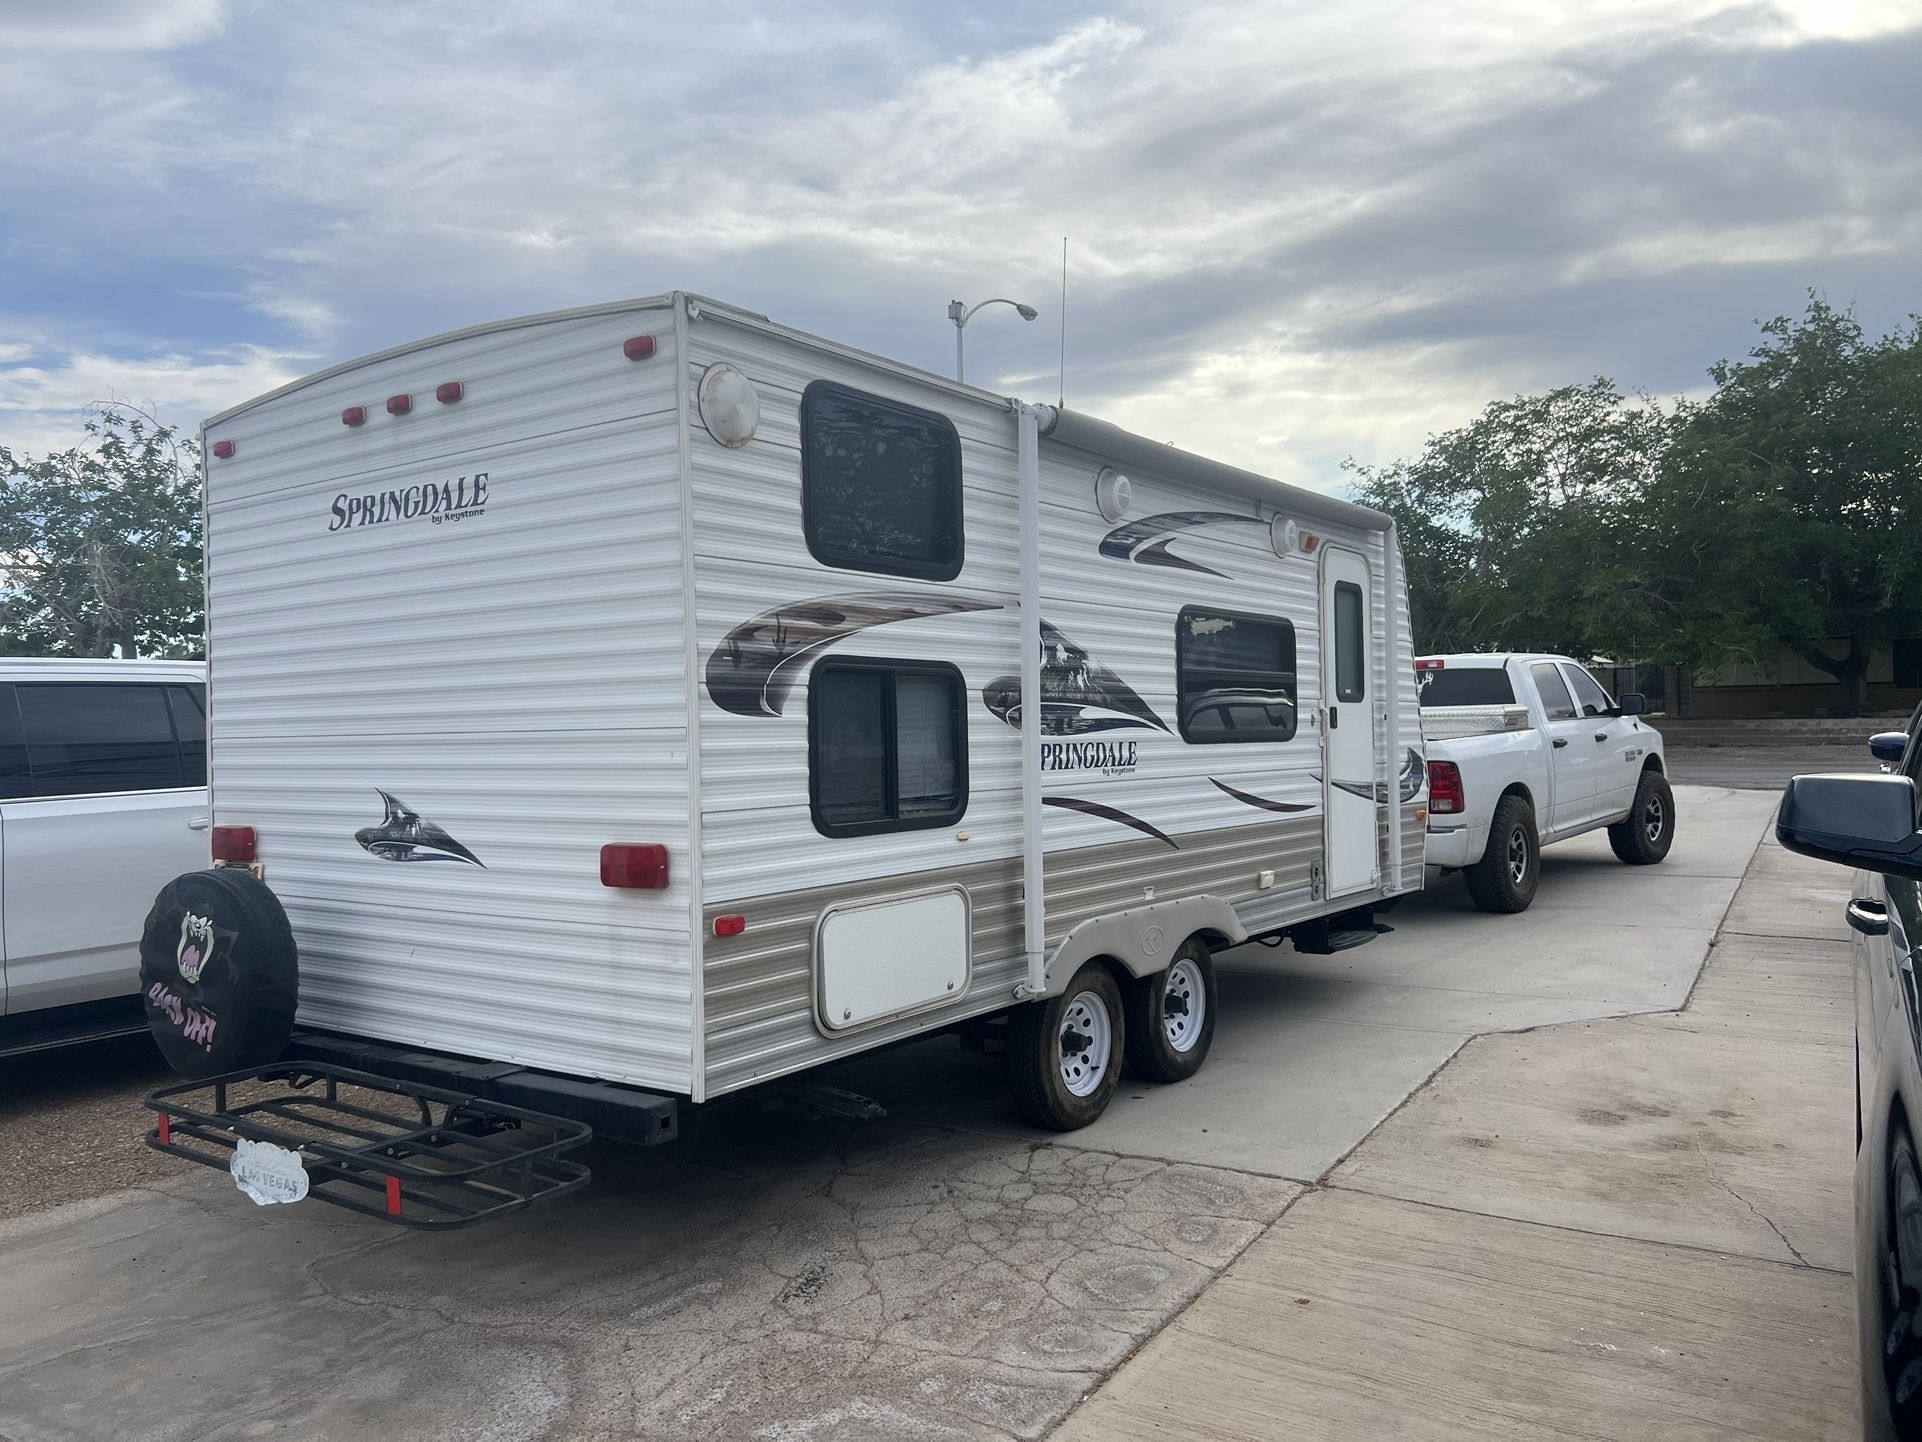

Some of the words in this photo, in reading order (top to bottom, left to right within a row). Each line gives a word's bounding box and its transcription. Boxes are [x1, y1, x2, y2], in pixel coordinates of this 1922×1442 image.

[328, 473, 489, 531] SPRINGDALE
[431, 513, 442, 525] by
[444, 508, 485, 522] Keystone
[1041, 741, 1138, 770] PRINGDALE
[1102, 768, 1110, 776] by
[1111, 767, 1136, 776] Keystone
[262, 1172, 298, 1193] VEGAS
